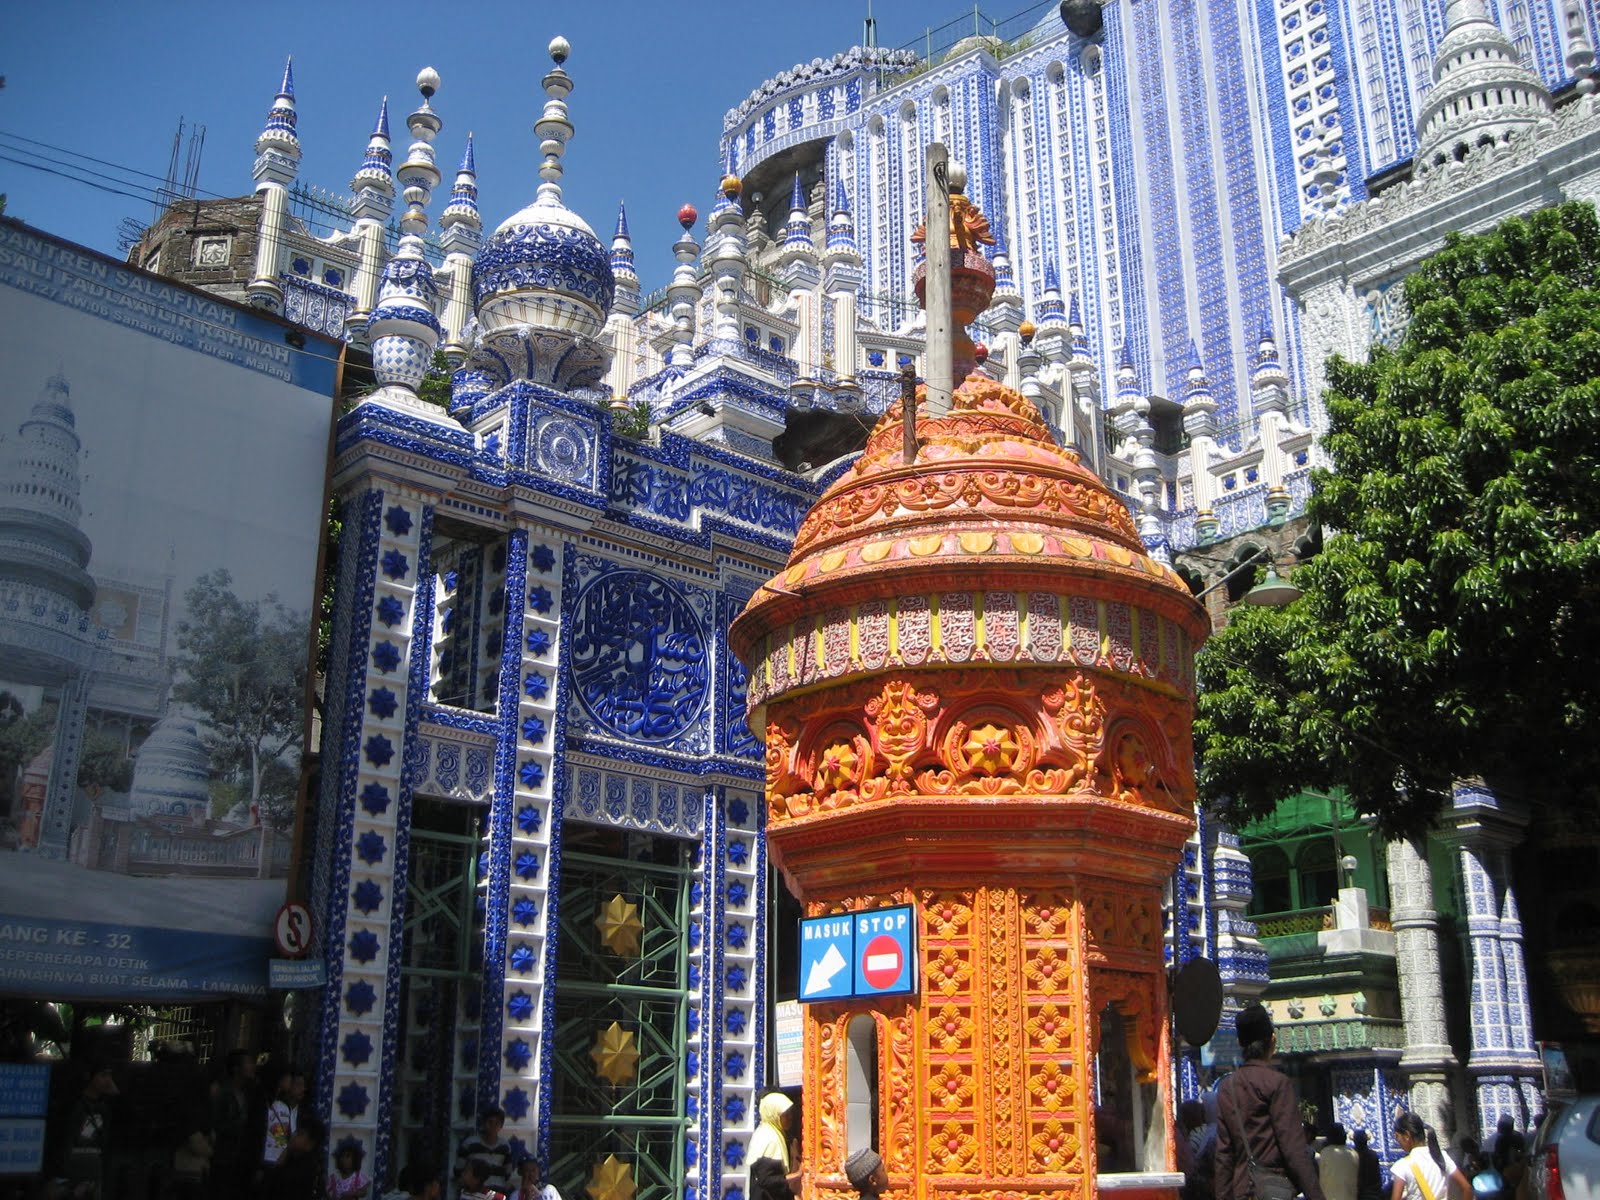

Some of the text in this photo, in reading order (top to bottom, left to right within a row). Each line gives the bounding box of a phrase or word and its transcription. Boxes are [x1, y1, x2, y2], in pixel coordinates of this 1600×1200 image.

[115, 271, 236, 324] SALAFIYAH
[16, 275, 58, 298] RT.27
[63, 291, 109, 316] RW.06
[114, 310, 183, 342] Sananrejo
[198, 340, 234, 360] Turen
[246, 356, 292, 382] Malang
[200, 320, 289, 364] RAHMAH
[804, 921, 850, 940] MASUK
[860, 914, 906, 934] STOP
[56, 929, 88, 946] KE
[105, 933, 132, 949] 32
[108, 956, 150, 970] DETIK
[89, 973, 127, 986] BUAT
[131, 975, 188, 989] SELAMA
